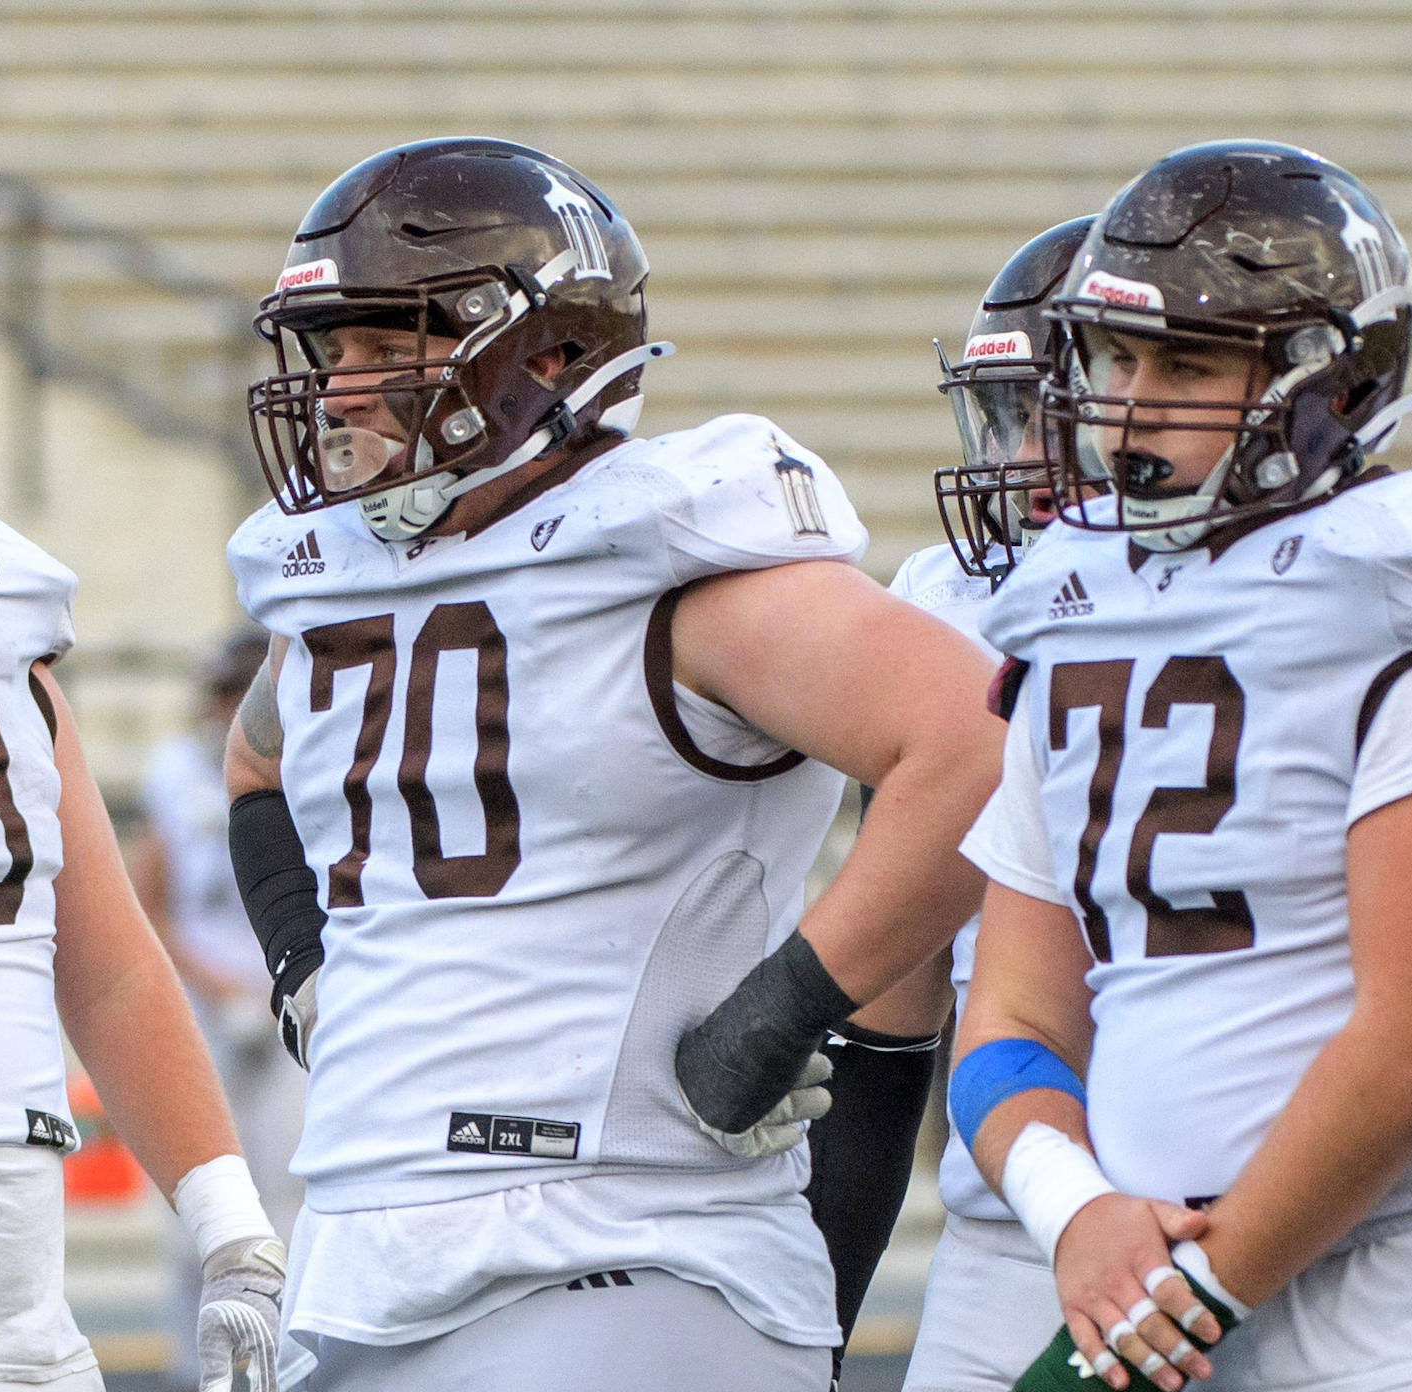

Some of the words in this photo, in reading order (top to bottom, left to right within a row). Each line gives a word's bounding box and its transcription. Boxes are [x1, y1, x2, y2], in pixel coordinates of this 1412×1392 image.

[280, 266, 324, 290] Riddell
[968, 338, 1017, 358] Riddell
[279, 558, 326, 578] adidas
[300, 600, 522, 910] 70
[1048, 654, 1255, 965] 72
[450, 1134, 486, 1146] adidas
[499, 1132, 523, 1147] 2XL
